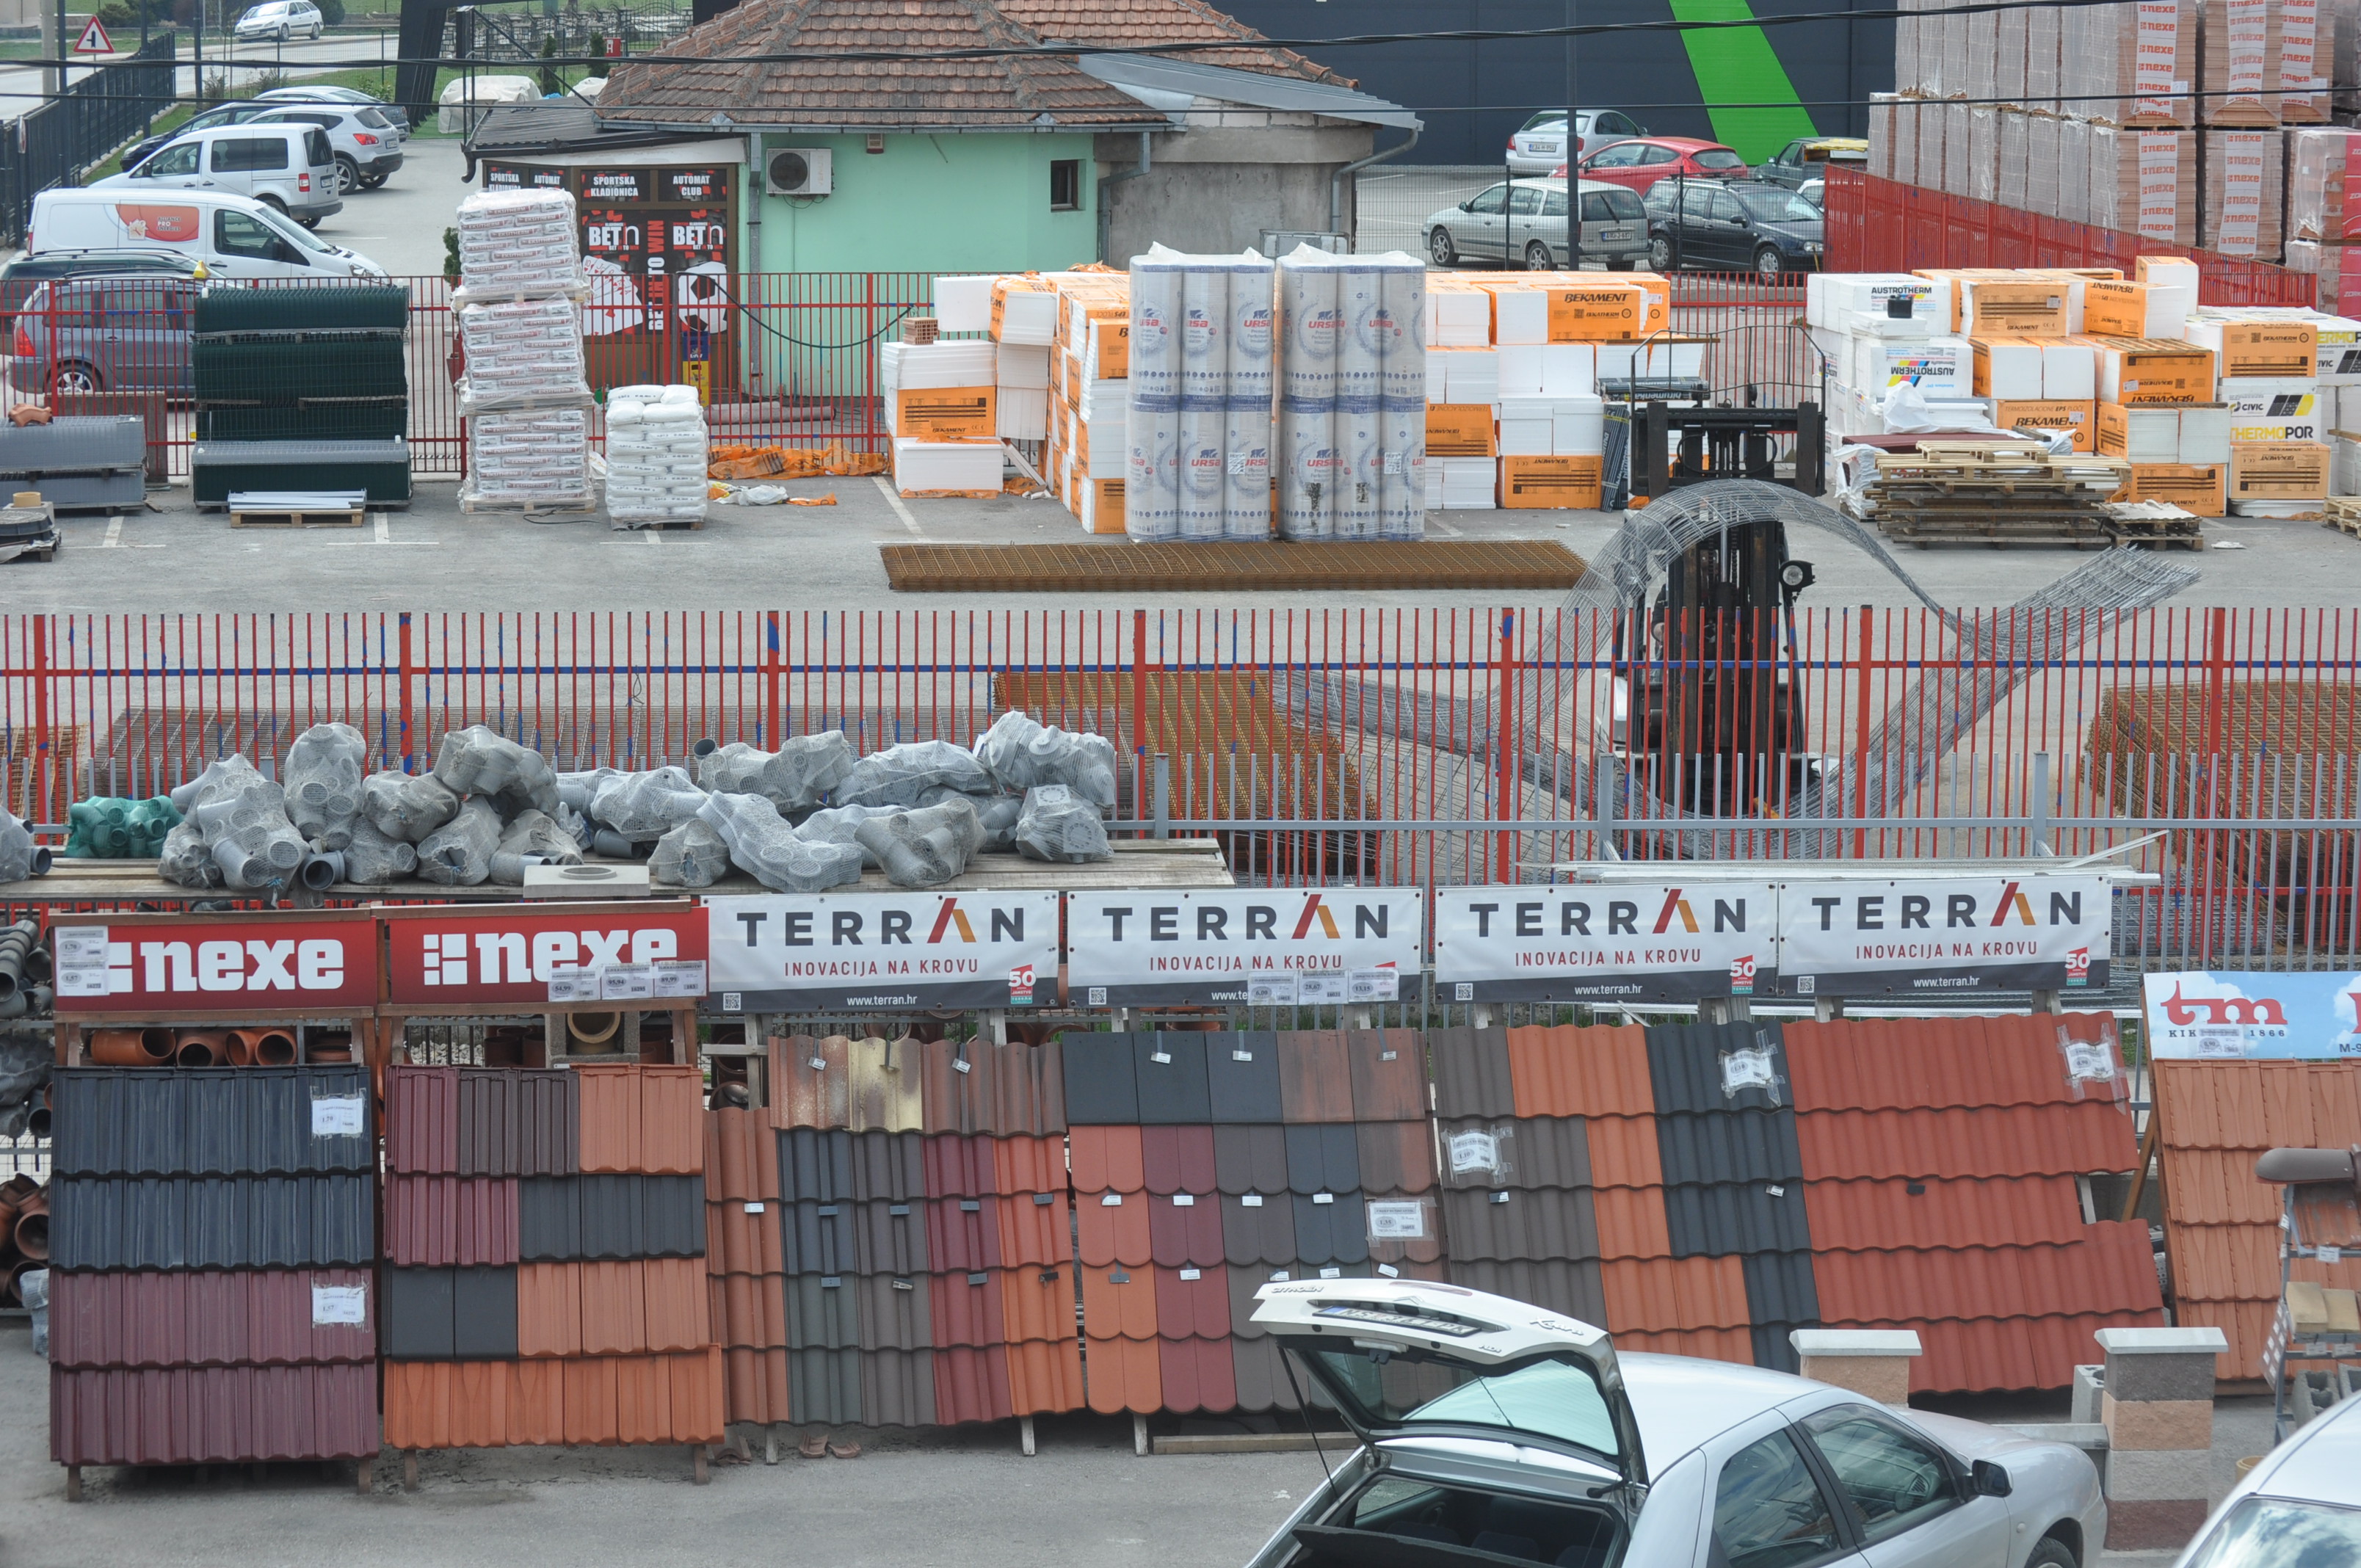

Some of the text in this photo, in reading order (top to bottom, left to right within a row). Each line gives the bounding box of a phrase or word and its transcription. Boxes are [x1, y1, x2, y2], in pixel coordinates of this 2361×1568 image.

[2147, 5, 2175, 13] nexe
[2237, 16, 2264, 24] nexe
[2288, 15, 2314, 24] nexe
[2288, 36, 2313, 46] nexe
[2147, 45, 2174, 54] nexe
[2287, 54, 2311, 63] nexe
[2144, 83, 2170, 92] nexe
[2148, 166, 2175, 174] nexe
[490, 173, 519, 183] SPORTSKA
[534, 175, 560, 184] AUTOMAT
[593, 176, 635, 185] SPORTSKA
[673, 175, 710, 184] AUTOMAT
[591, 187, 639, 196] KLADIONICA
[681, 186, 702, 196] CLUB
[2149, 184, 2175, 194] nexe
[2233, 196, 2258, 204] nexe
[648, 220, 664, 253] WIN
[2227, 236, 2255, 244] nexe
[1564, 294, 1629, 303] BEKAMENT
[1891, 366, 1955, 376] AUSTROTHERM
[2242, 403, 2264, 411] CIVIC
[1812, 882, 2081, 931] TERRAN
[1102, 894, 1388, 941] TERRAN
[1469, 889, 1746, 937] TERRAN
[737, 897, 1024, 946] TERRAN
[1856, 941, 2037, 959] INOVACIJA NA KROVU
[475, 929, 677, 984] nexe
[1515, 948, 1701, 967] INOVACIJA NA KROVU
[2064, 953, 2091, 969] 50
[139, 939, 344, 992] nexe
[784, 959, 979, 977] INOVACIJA NA KROVU
[1150, 954, 1342, 972] INOVACIJA NA KROVU
[1730, 961, 1757, 977] 50
[1008, 970, 1037, 987] 50
[1914, 976, 1980, 988] www.terran.hr
[1575, 984, 1643, 995] www.terran.hr
[846, 994, 917, 1006] www.terran.hr
[2160, 980, 2288, 1026] tm
[2250, 1029, 2285, 1037] 1866
